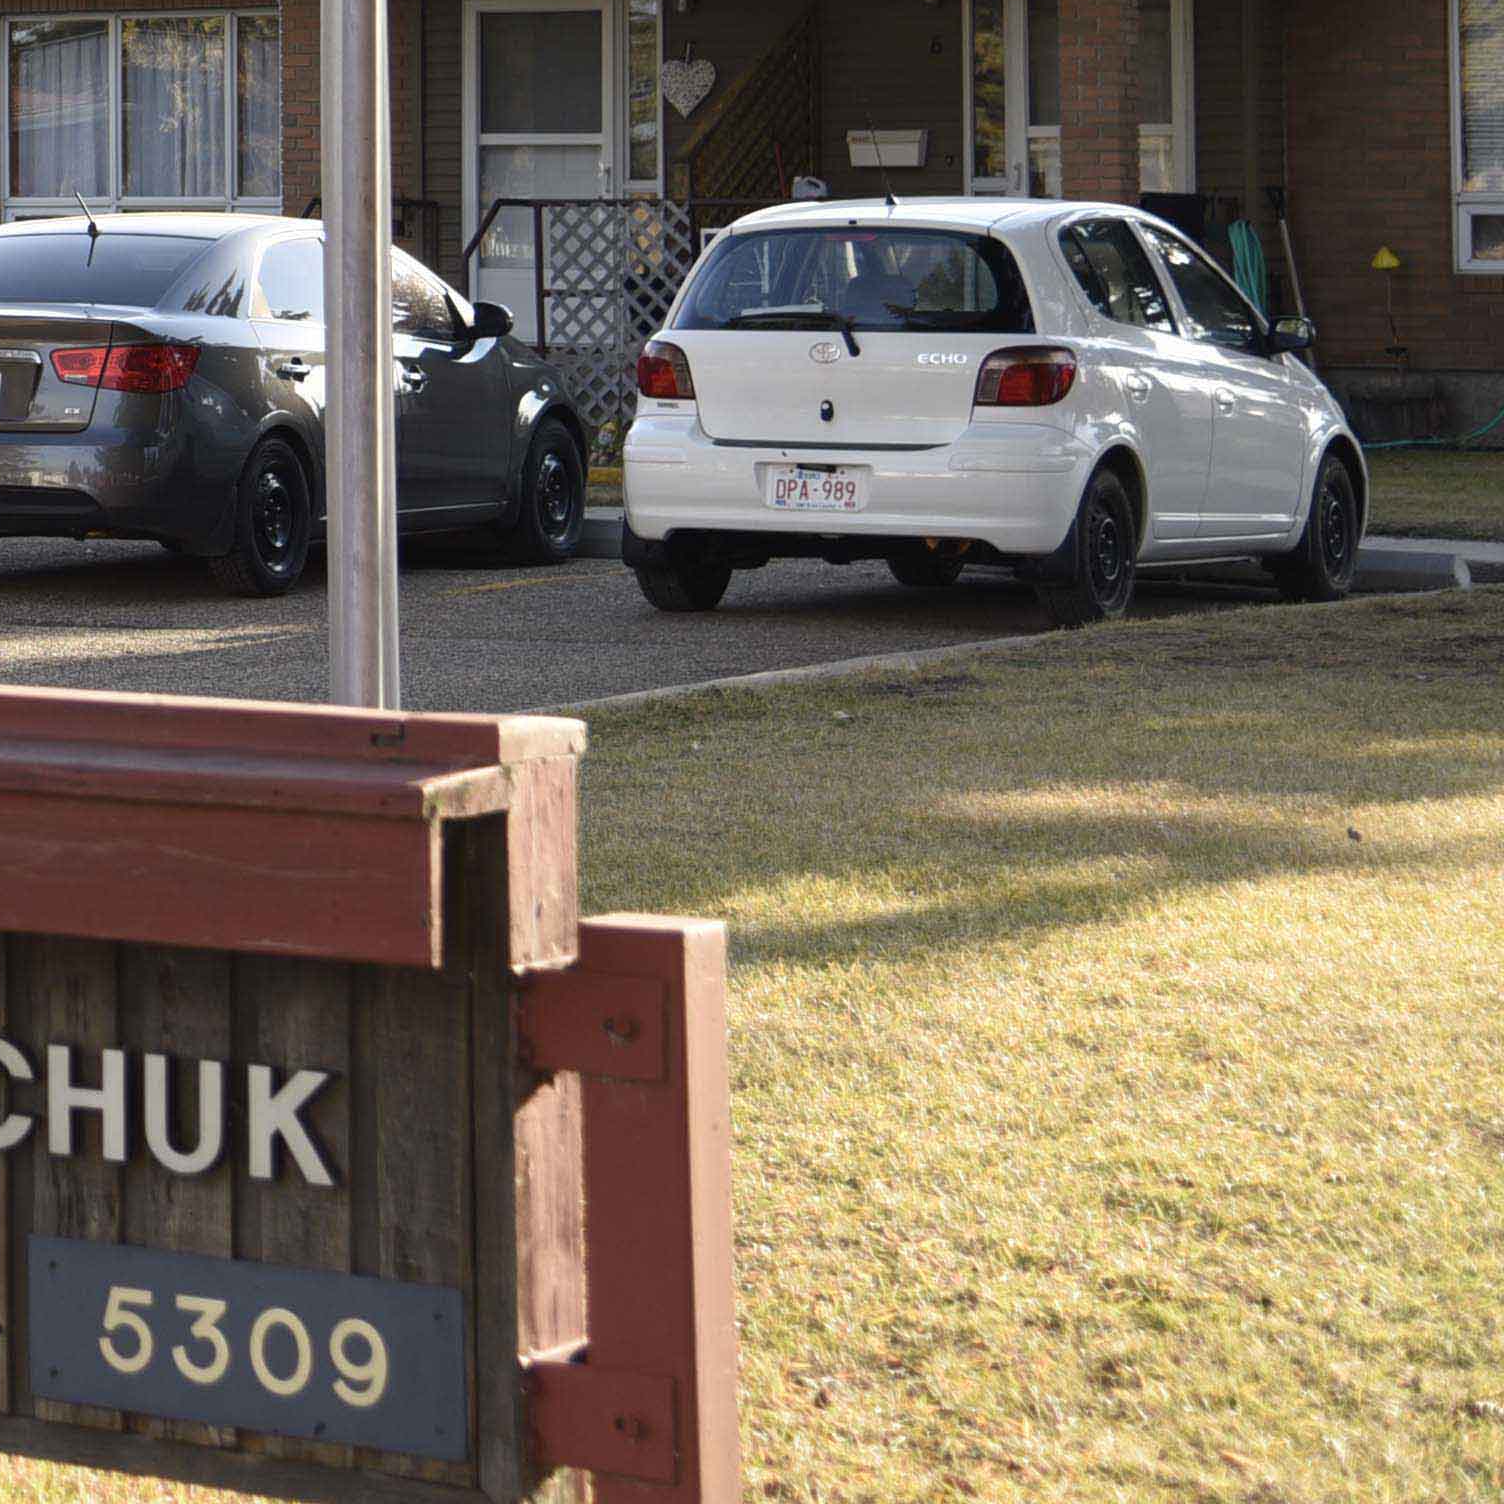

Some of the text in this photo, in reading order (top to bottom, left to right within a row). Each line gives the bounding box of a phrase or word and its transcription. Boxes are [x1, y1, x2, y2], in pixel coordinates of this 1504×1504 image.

[917, 352, 968, 365] ECHO
[776, 479, 856, 501] DPA-989
[98, 1285, 389, 1408] 5309
